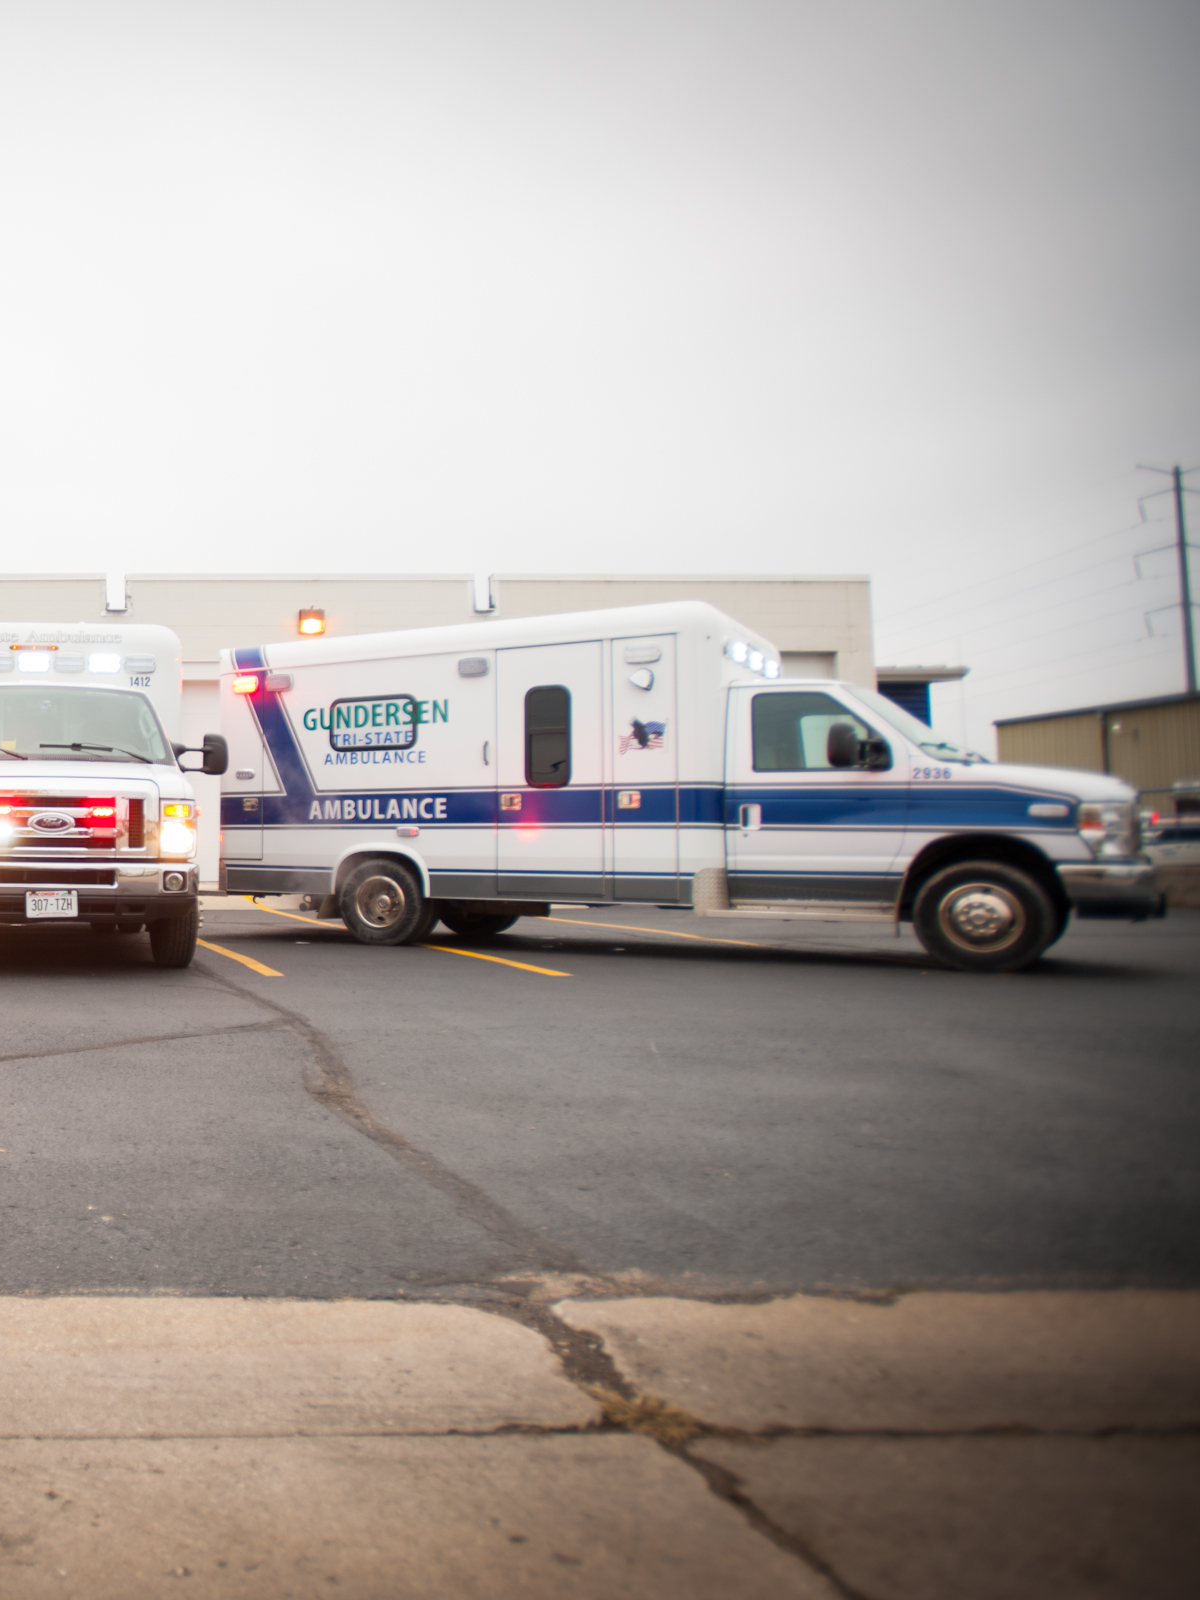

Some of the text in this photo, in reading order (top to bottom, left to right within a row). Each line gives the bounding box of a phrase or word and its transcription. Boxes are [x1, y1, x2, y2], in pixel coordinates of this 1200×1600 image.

[26, 629, 123, 644] Ambulance
[129, 676, 151, 687] 1412
[303, 699, 449, 730] GUNDERSEN
[334, 731, 413, 746] TRI-STATE
[324, 751, 427, 765] AMBULANCE
[913, 767, 952, 779] 2936
[309, 798, 448, 820] AMBULANCE
[31, 898, 73, 911] 307-TZH
